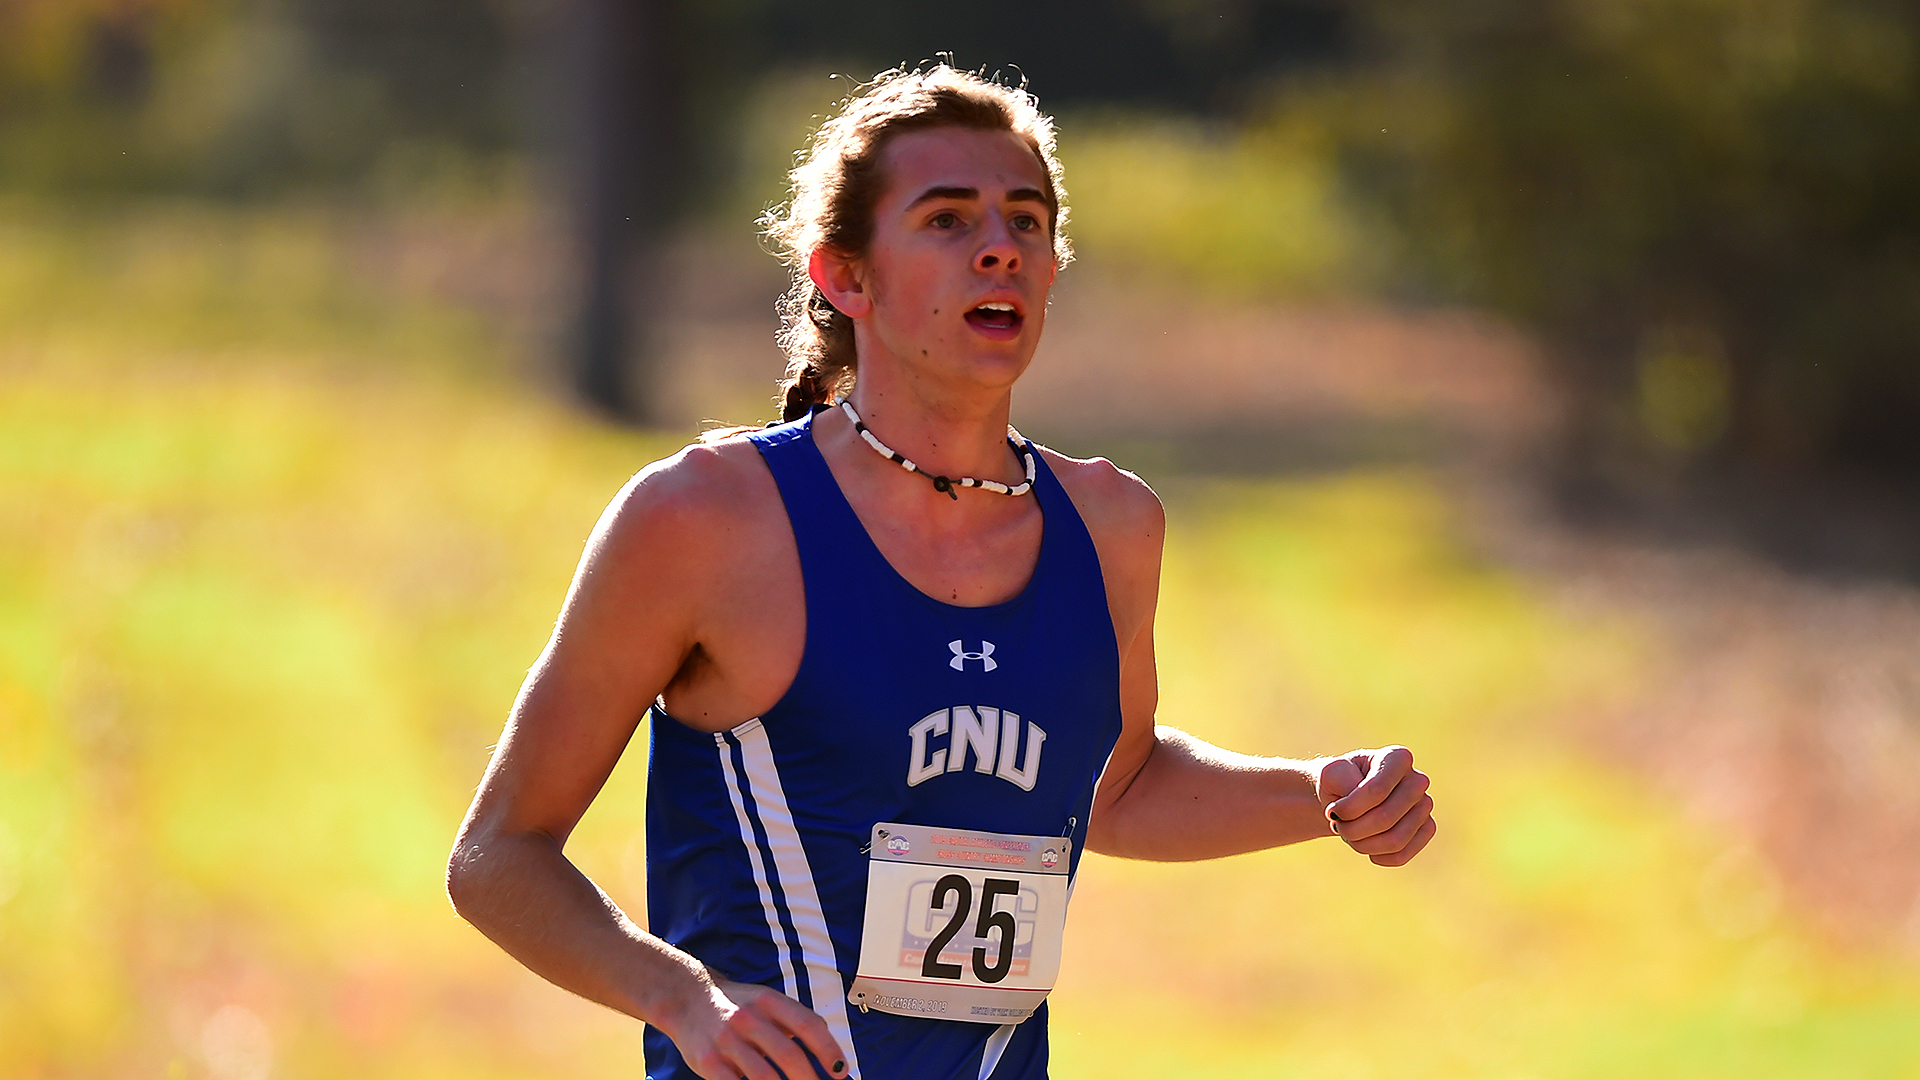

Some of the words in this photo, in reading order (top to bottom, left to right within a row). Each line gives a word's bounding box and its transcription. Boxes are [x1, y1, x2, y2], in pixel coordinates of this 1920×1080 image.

[907, 704, 1047, 792] CNU
[887, 838, 910, 851] CAC
[921, 873, 1020, 984] 25
[873, 995, 918, 1011] NOVEMBER
[927, 1000, 948, 1014] 2019
